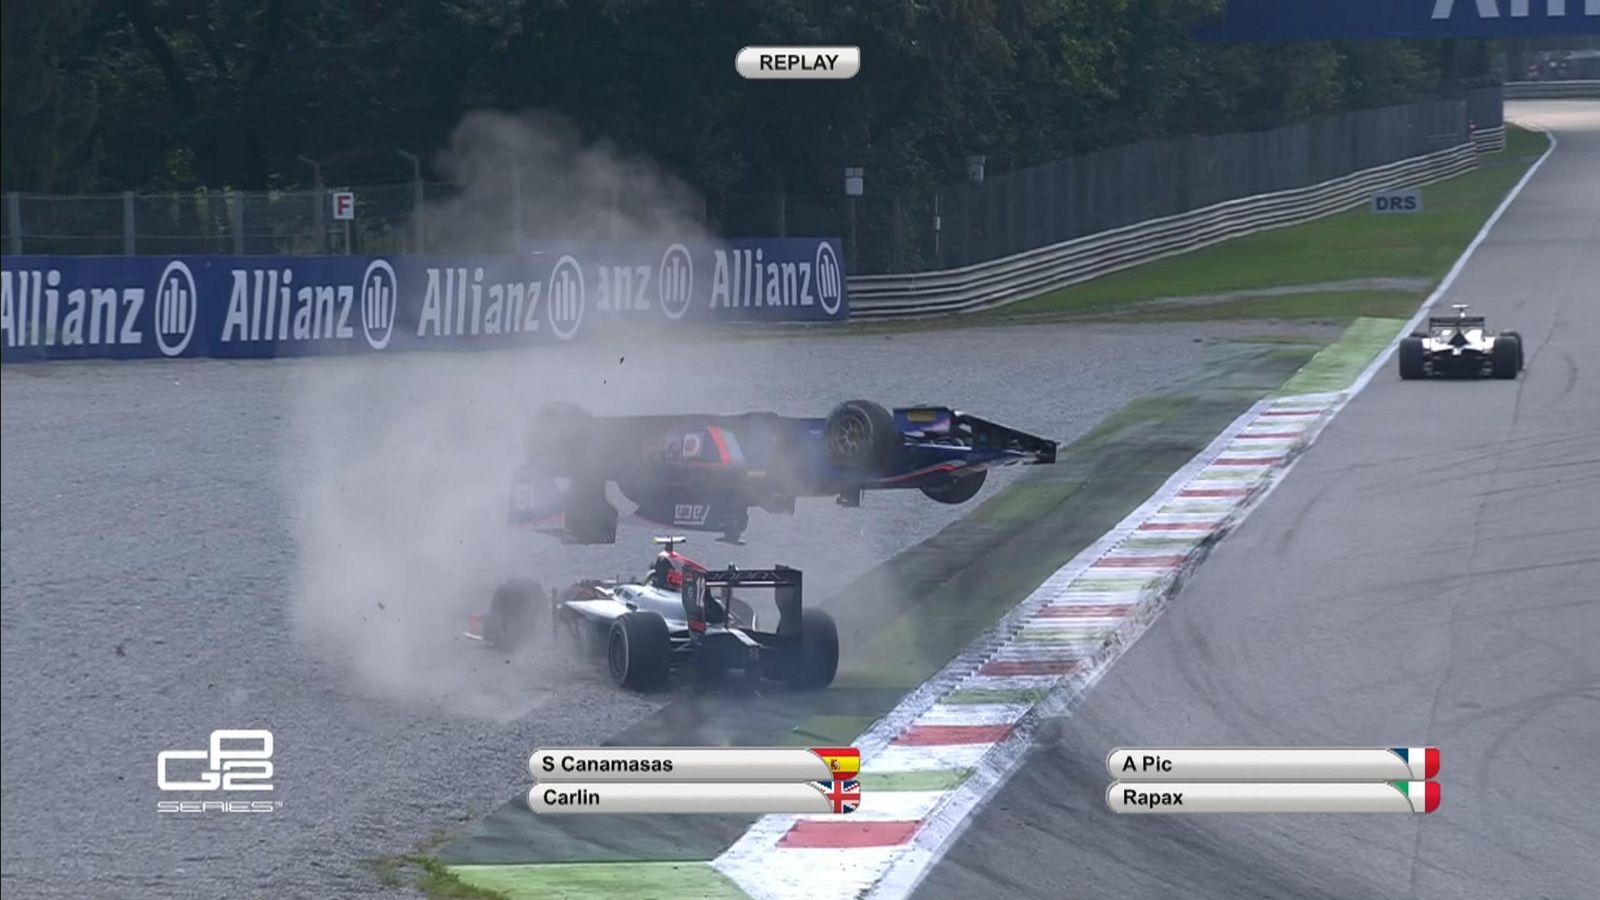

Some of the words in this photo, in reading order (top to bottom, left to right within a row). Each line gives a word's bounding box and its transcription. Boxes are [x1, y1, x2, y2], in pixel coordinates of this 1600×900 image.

[337, 195, 352, 216] F
[1375, 195, 1417, 211] DRS
[222, 269, 355, 341] Allianz
[417, 267, 541, 336] Allianz
[708, 249, 813, 308] Allianz
